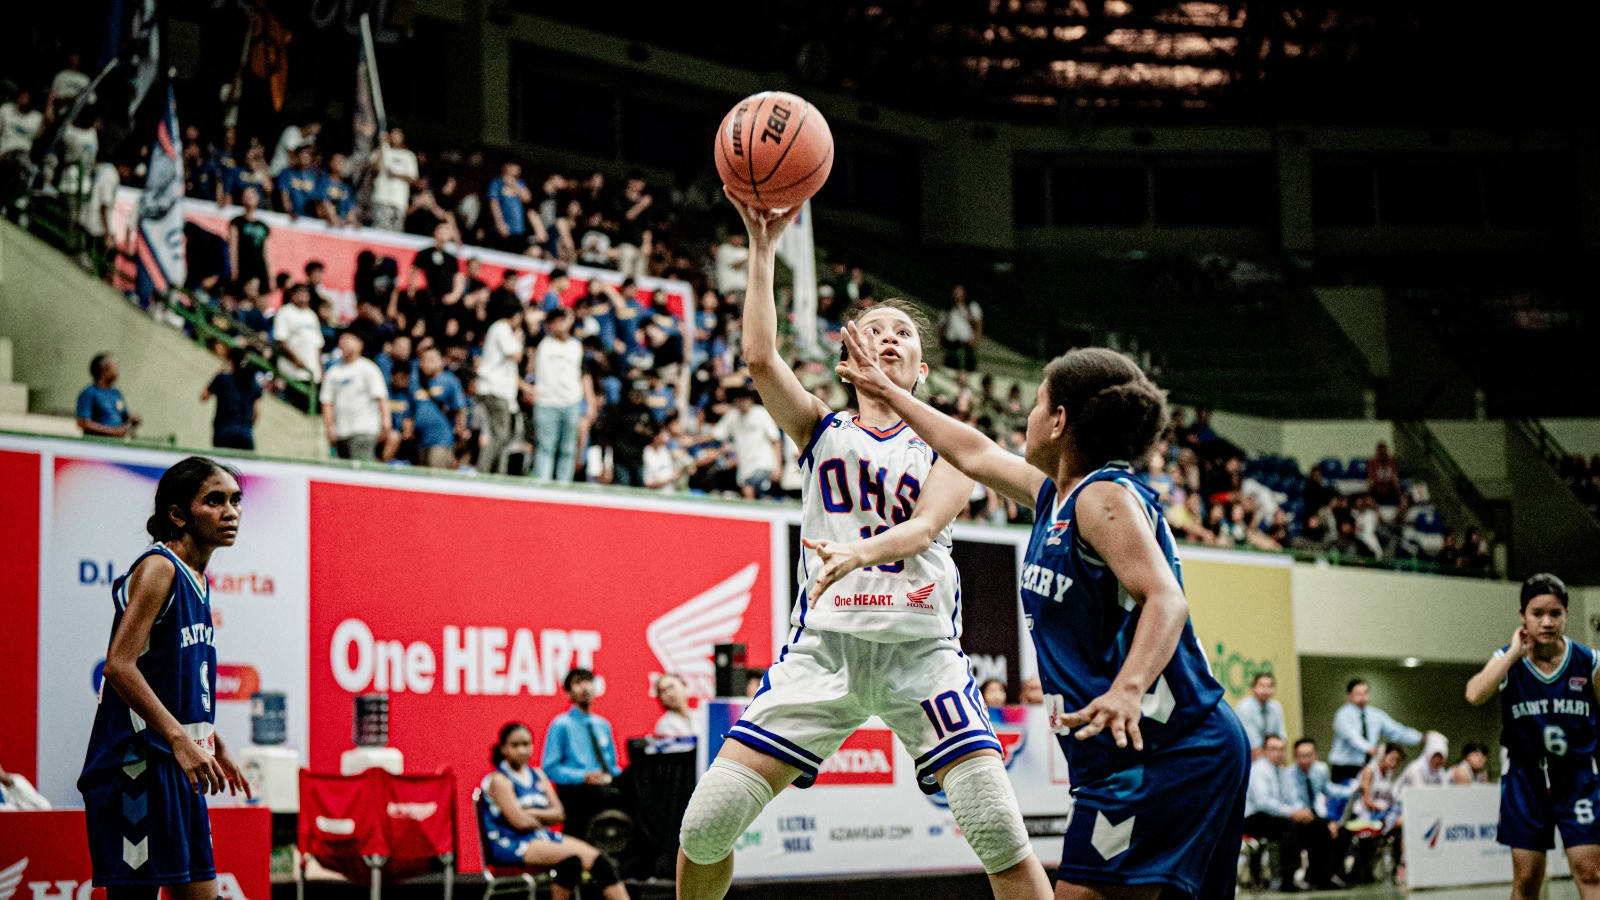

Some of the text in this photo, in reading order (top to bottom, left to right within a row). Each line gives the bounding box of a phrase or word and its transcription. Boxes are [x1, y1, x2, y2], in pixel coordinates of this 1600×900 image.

[818, 458, 921, 526] OHS
[834, 594, 894, 607] One HEART.
[906, 602, 934, 610] HONDA
[331, 618, 436, 693] One
[442, 625, 606, 697] HEART.
[920, 690, 970, 741] 10
[1511, 698, 1549, 719] SAINT
[1543, 724, 1568, 757] 6
[820, 748, 891, 774] NDA
